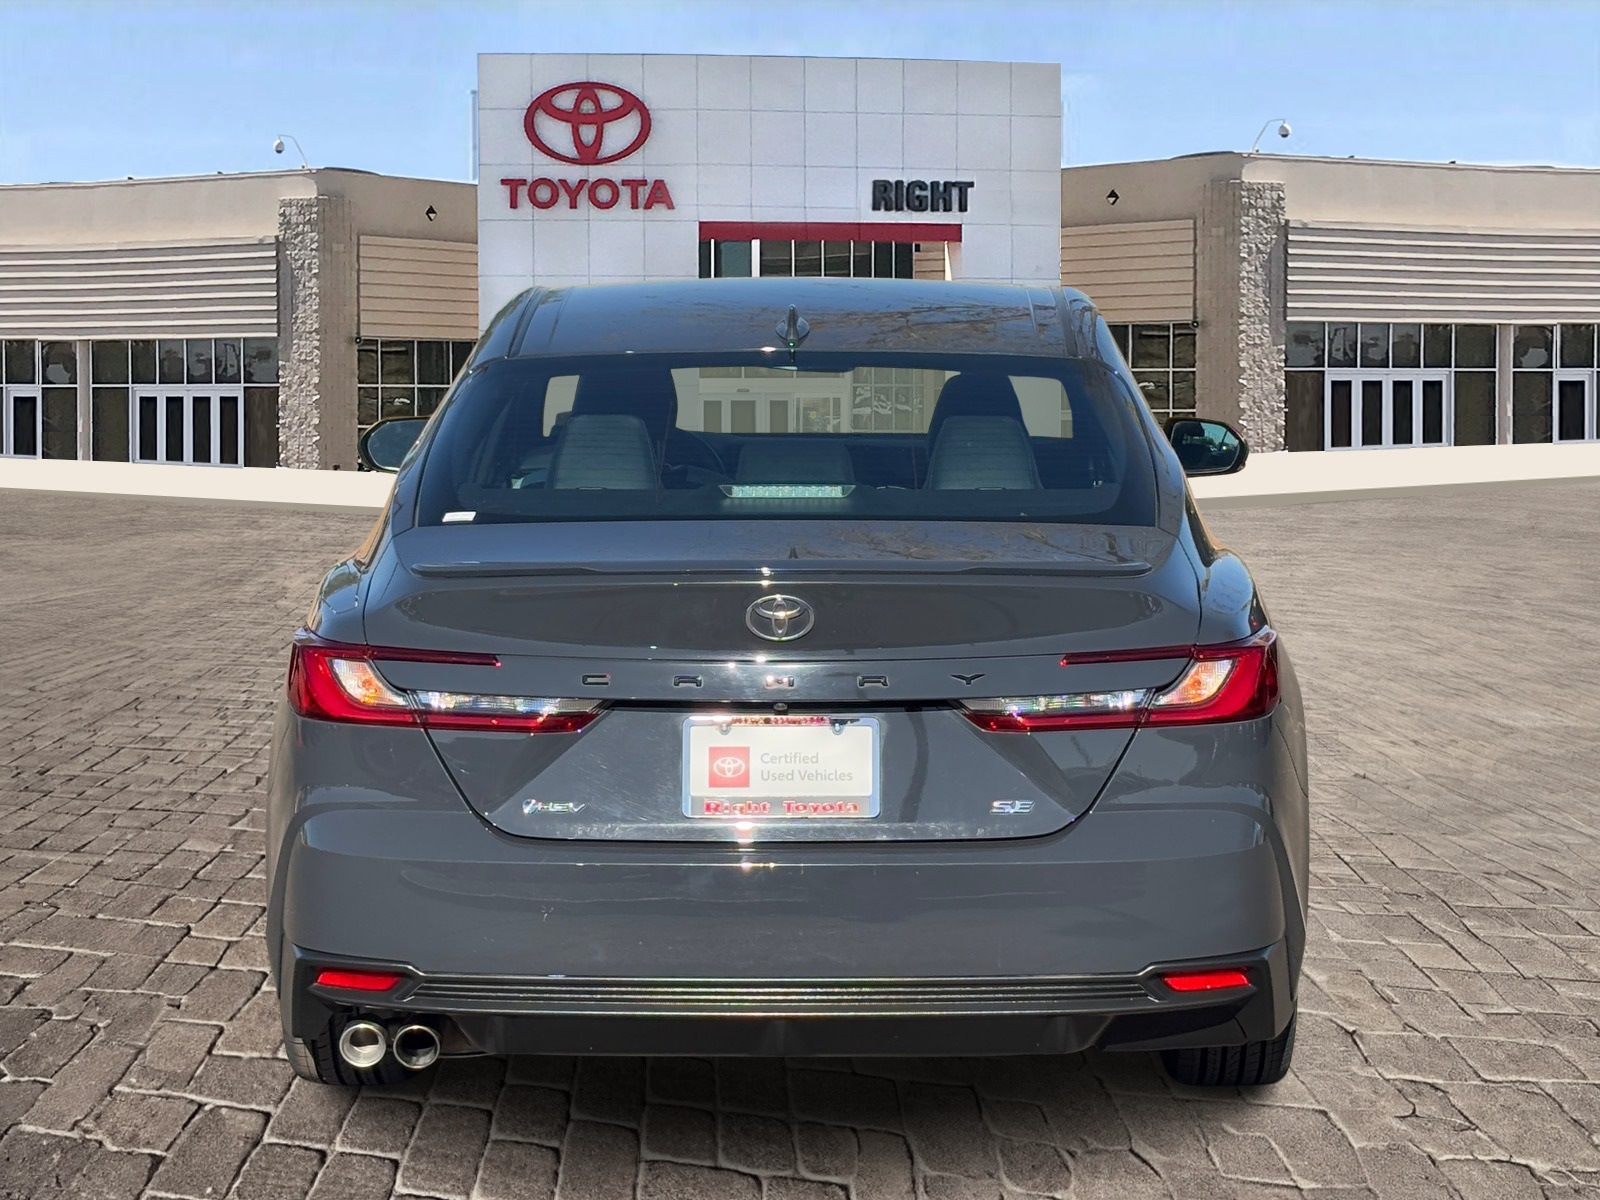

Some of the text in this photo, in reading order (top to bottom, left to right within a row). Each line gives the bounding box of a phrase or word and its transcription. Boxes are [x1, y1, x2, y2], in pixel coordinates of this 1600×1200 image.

[500, 177, 675, 210] TOYOTA
[871, 179, 975, 213] RIGHT
[581, 673, 985, 688] CAMRY
[760, 752, 819, 764] Certified
[760, 769, 853, 782] Used Vehicles
[703, 800, 860, 815] Right Toyota
[990, 800, 1036, 815] SE
